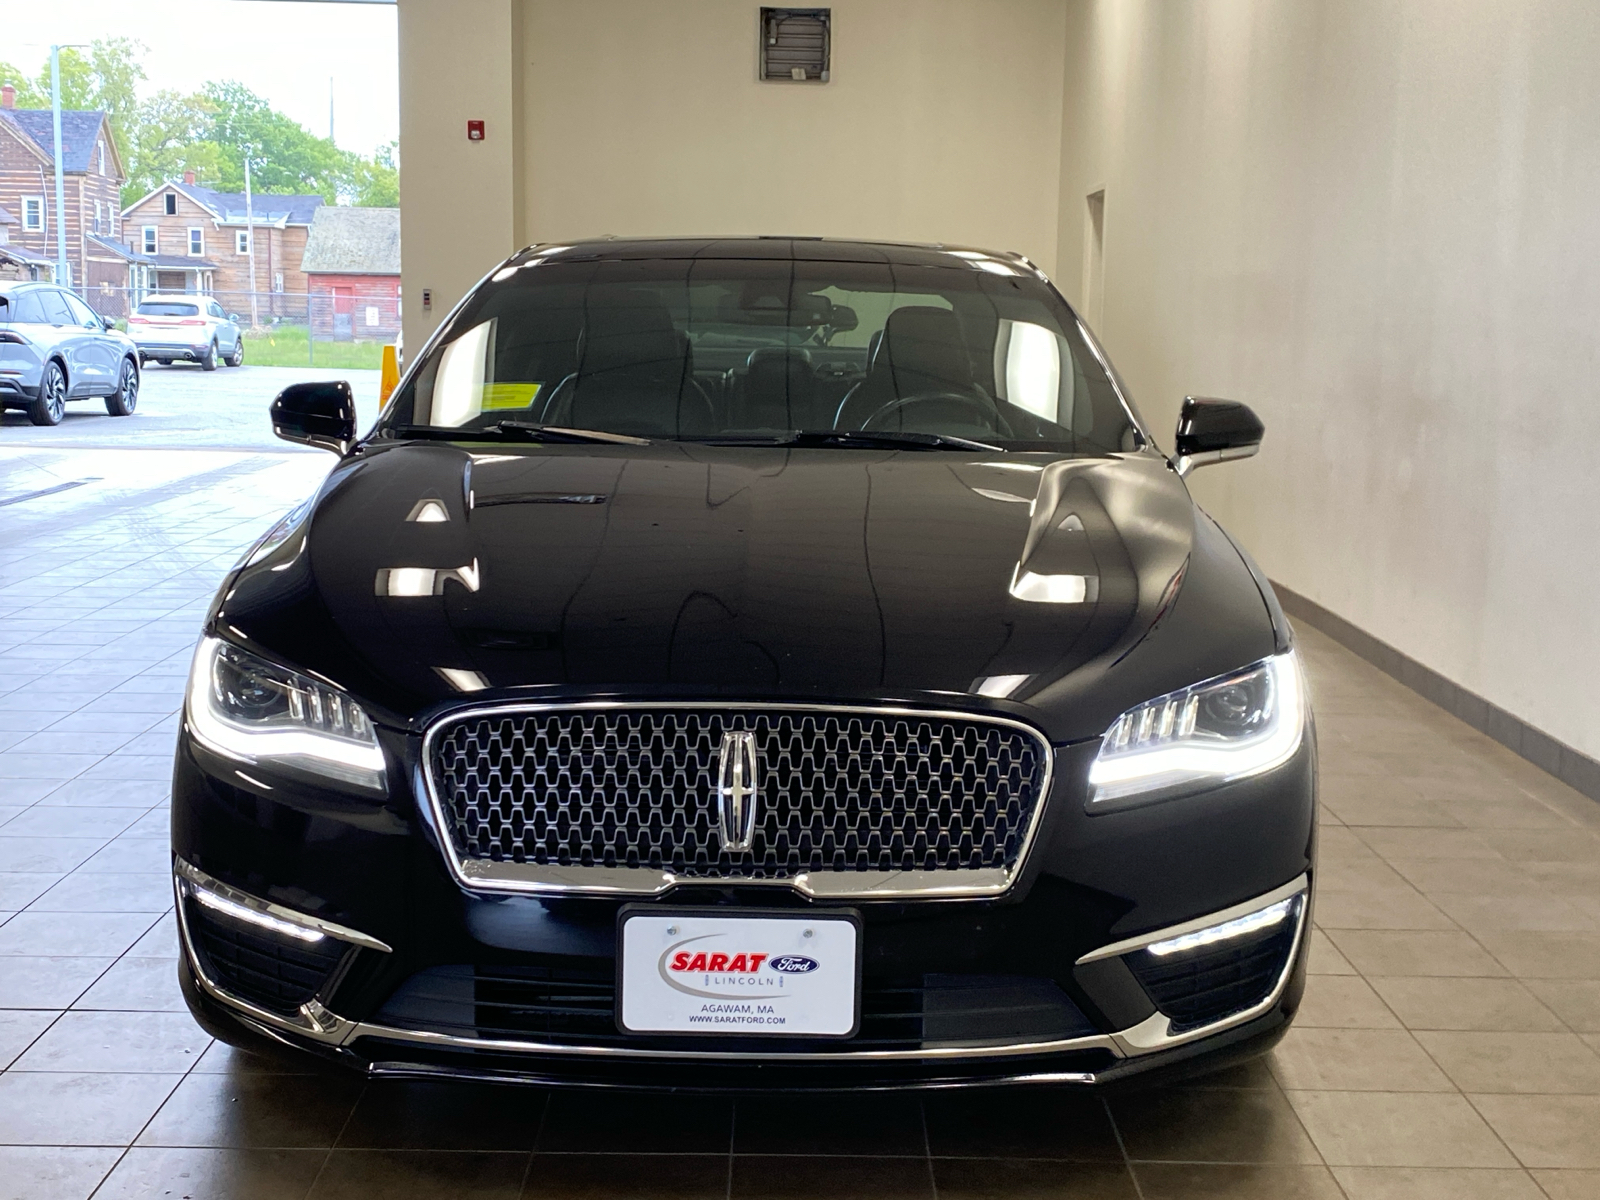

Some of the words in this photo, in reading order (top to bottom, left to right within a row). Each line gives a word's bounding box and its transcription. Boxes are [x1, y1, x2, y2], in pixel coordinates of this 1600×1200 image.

[670, 951, 769, 973] SARAT
[777, 957, 811, 972] Ford
[715, 977, 774, 986] LINCOLN
[701, 1004, 754, 1015] AGAWAM,
[757, 1005, 774, 1014] MA
[689, 1015, 786, 1024] WWW.SARATFORD.COM
